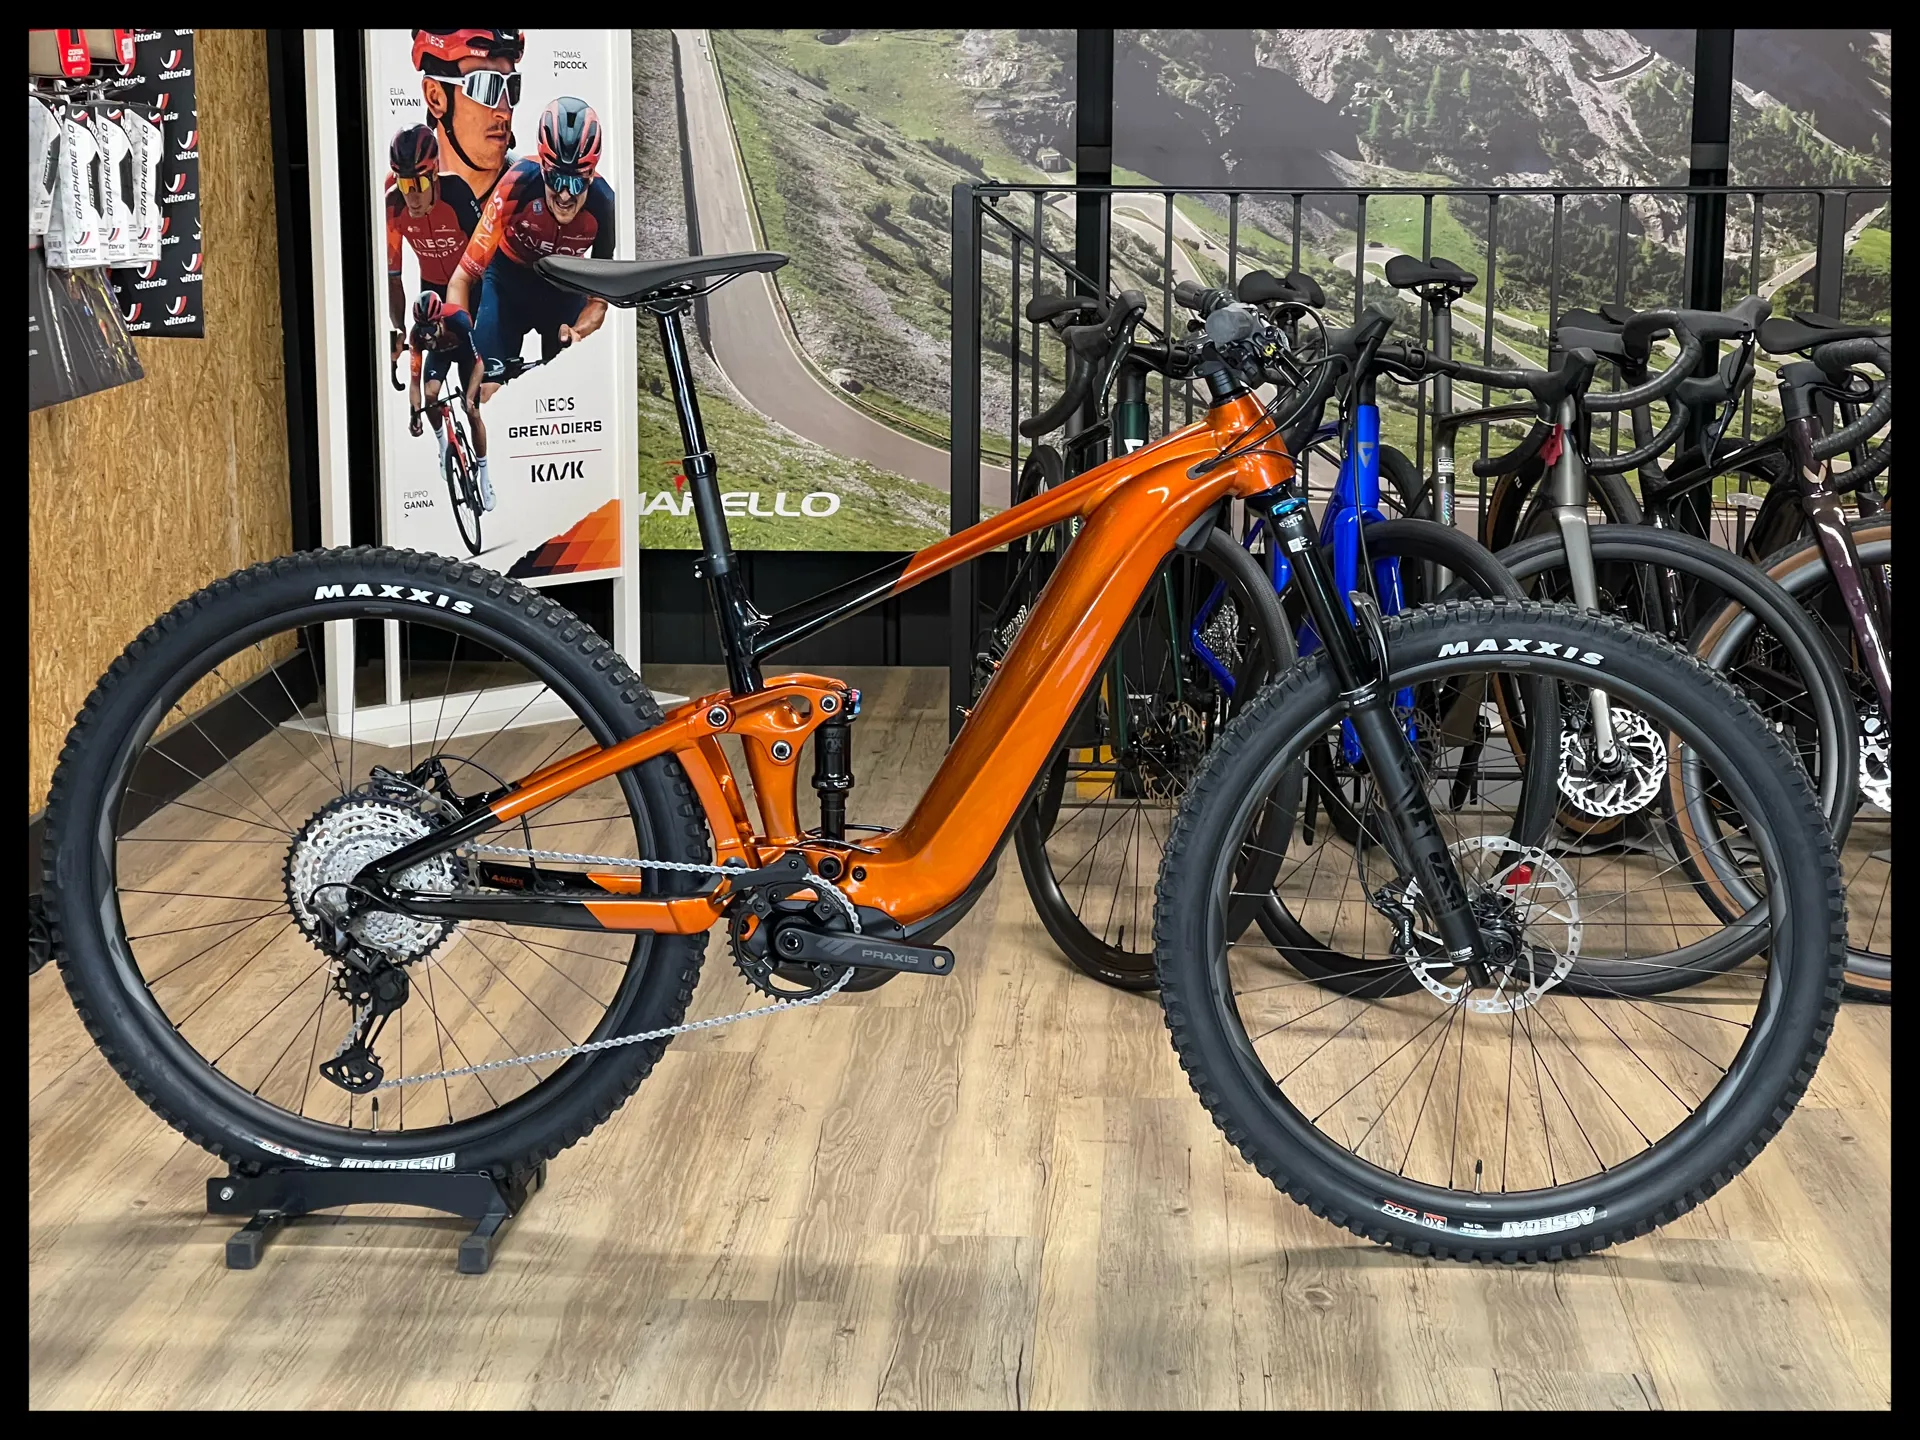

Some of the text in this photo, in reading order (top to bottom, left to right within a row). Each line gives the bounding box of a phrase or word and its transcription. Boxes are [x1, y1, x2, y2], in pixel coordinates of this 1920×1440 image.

[134, 31, 162, 42] ittoria
[553, 51, 581, 59] THOMAS
[553, 61, 588, 70] PIDCOCK
[159, 68, 191, 81] vittoria
[389, 88, 405, 96] ELIA
[390, 98, 421, 107] VIVIANI
[67, 124, 83, 220] GRAPHENE 2.0
[101, 122, 114, 216] GRAPHENE 2.0
[140, 124, 149, 216] GRAPHENE 2.0
[163, 191, 195, 204] vittoria
[161, 235, 180, 245] oria
[135, 278, 168, 290] vittoria
[163, 314, 196, 326] vittoria
[535, 397, 575, 413] INEOS
[508, 420, 602, 438] GRENADIERS
[531, 460, 584, 483] KASK
[404, 490, 428, 499] FILIPPO
[404, 499, 434, 509] GANNA
[314, 583, 475, 615] MAXXIS
[1437, 638, 1605, 666] MAXXIS
[861, 949, 919, 964] PRAXIS
[1501, 1206, 1596, 1238] ASSEGAI
